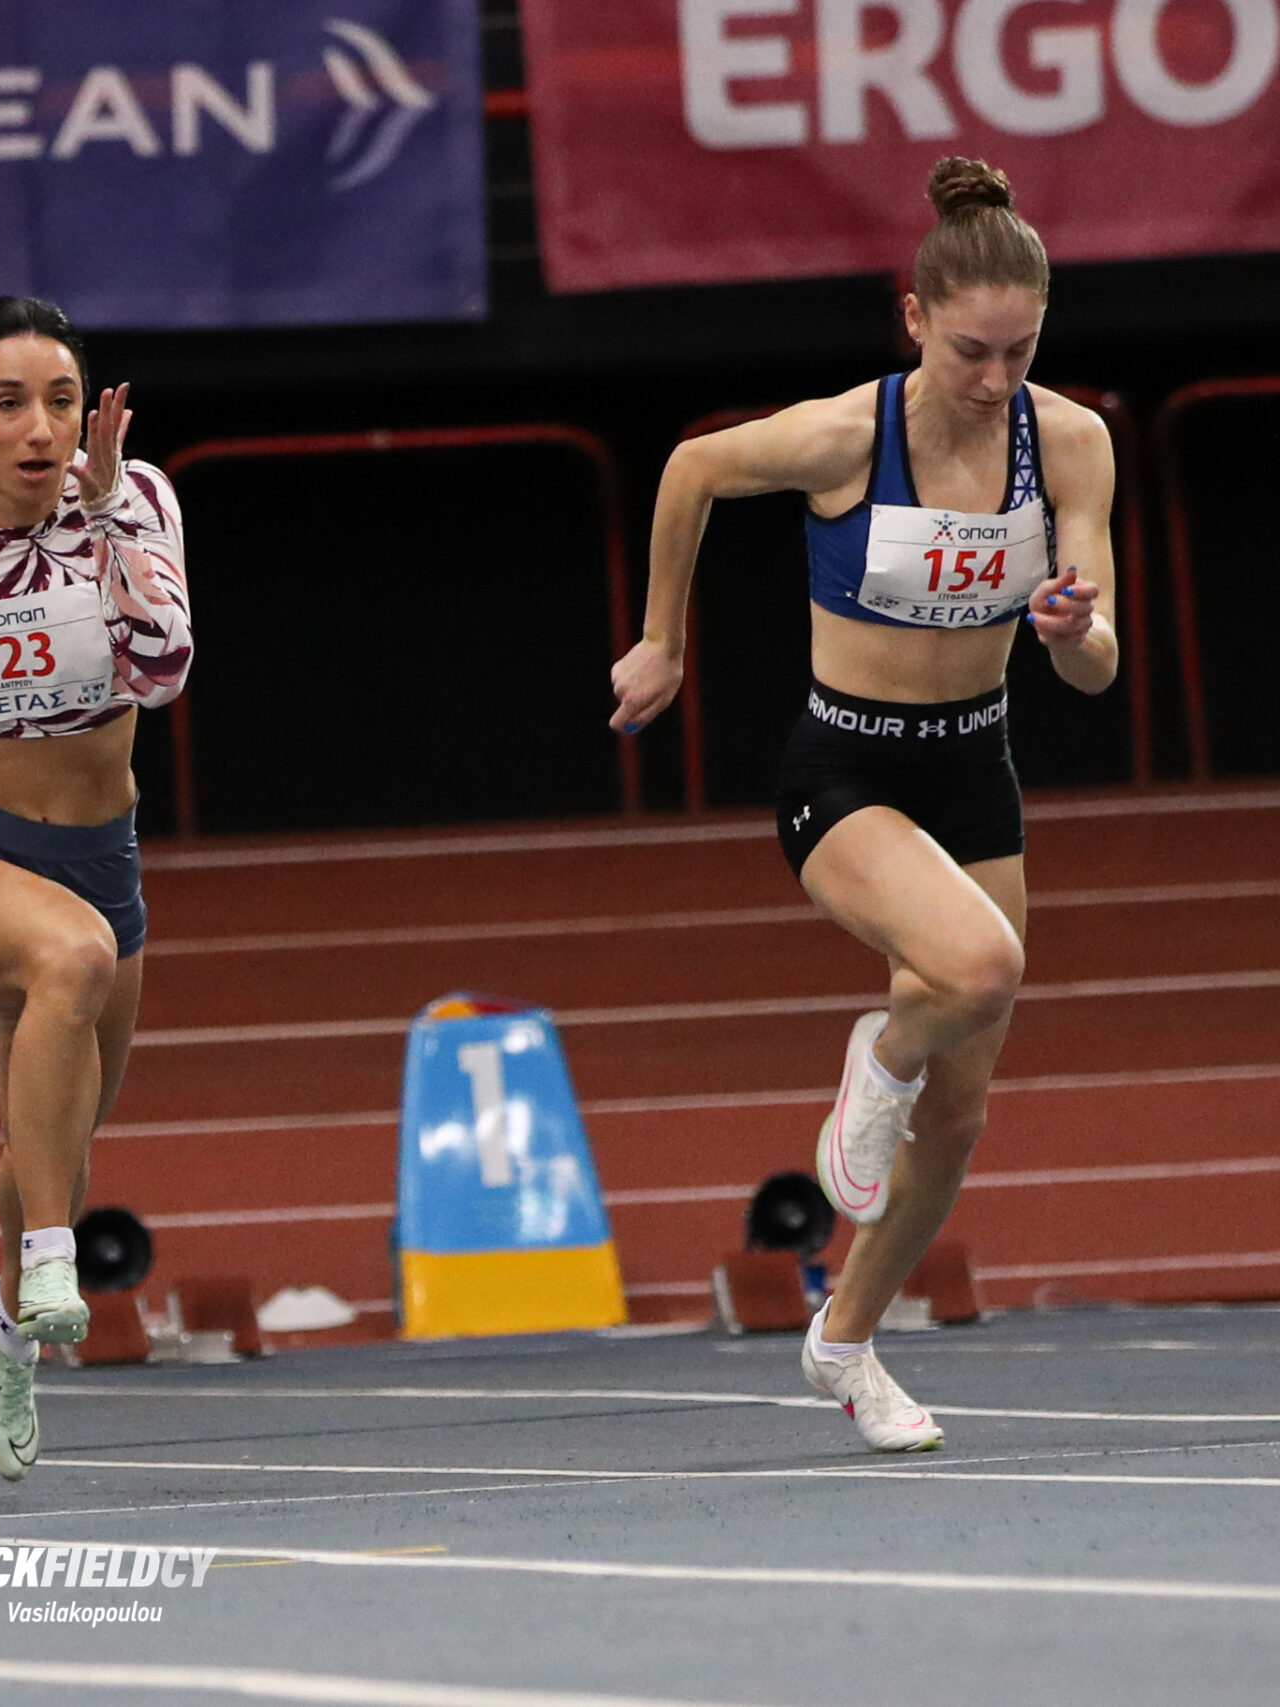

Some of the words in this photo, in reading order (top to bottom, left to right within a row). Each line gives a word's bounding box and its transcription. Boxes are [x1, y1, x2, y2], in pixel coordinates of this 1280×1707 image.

[677, 0, 1280, 151] ERGO
[923, 548, 1006, 592] 154
[909, 604, 999, 623] ΣΕΓΑΣ
[808, 688, 906, 738] RMOUR
[456, 1041, 514, 1187] 1
